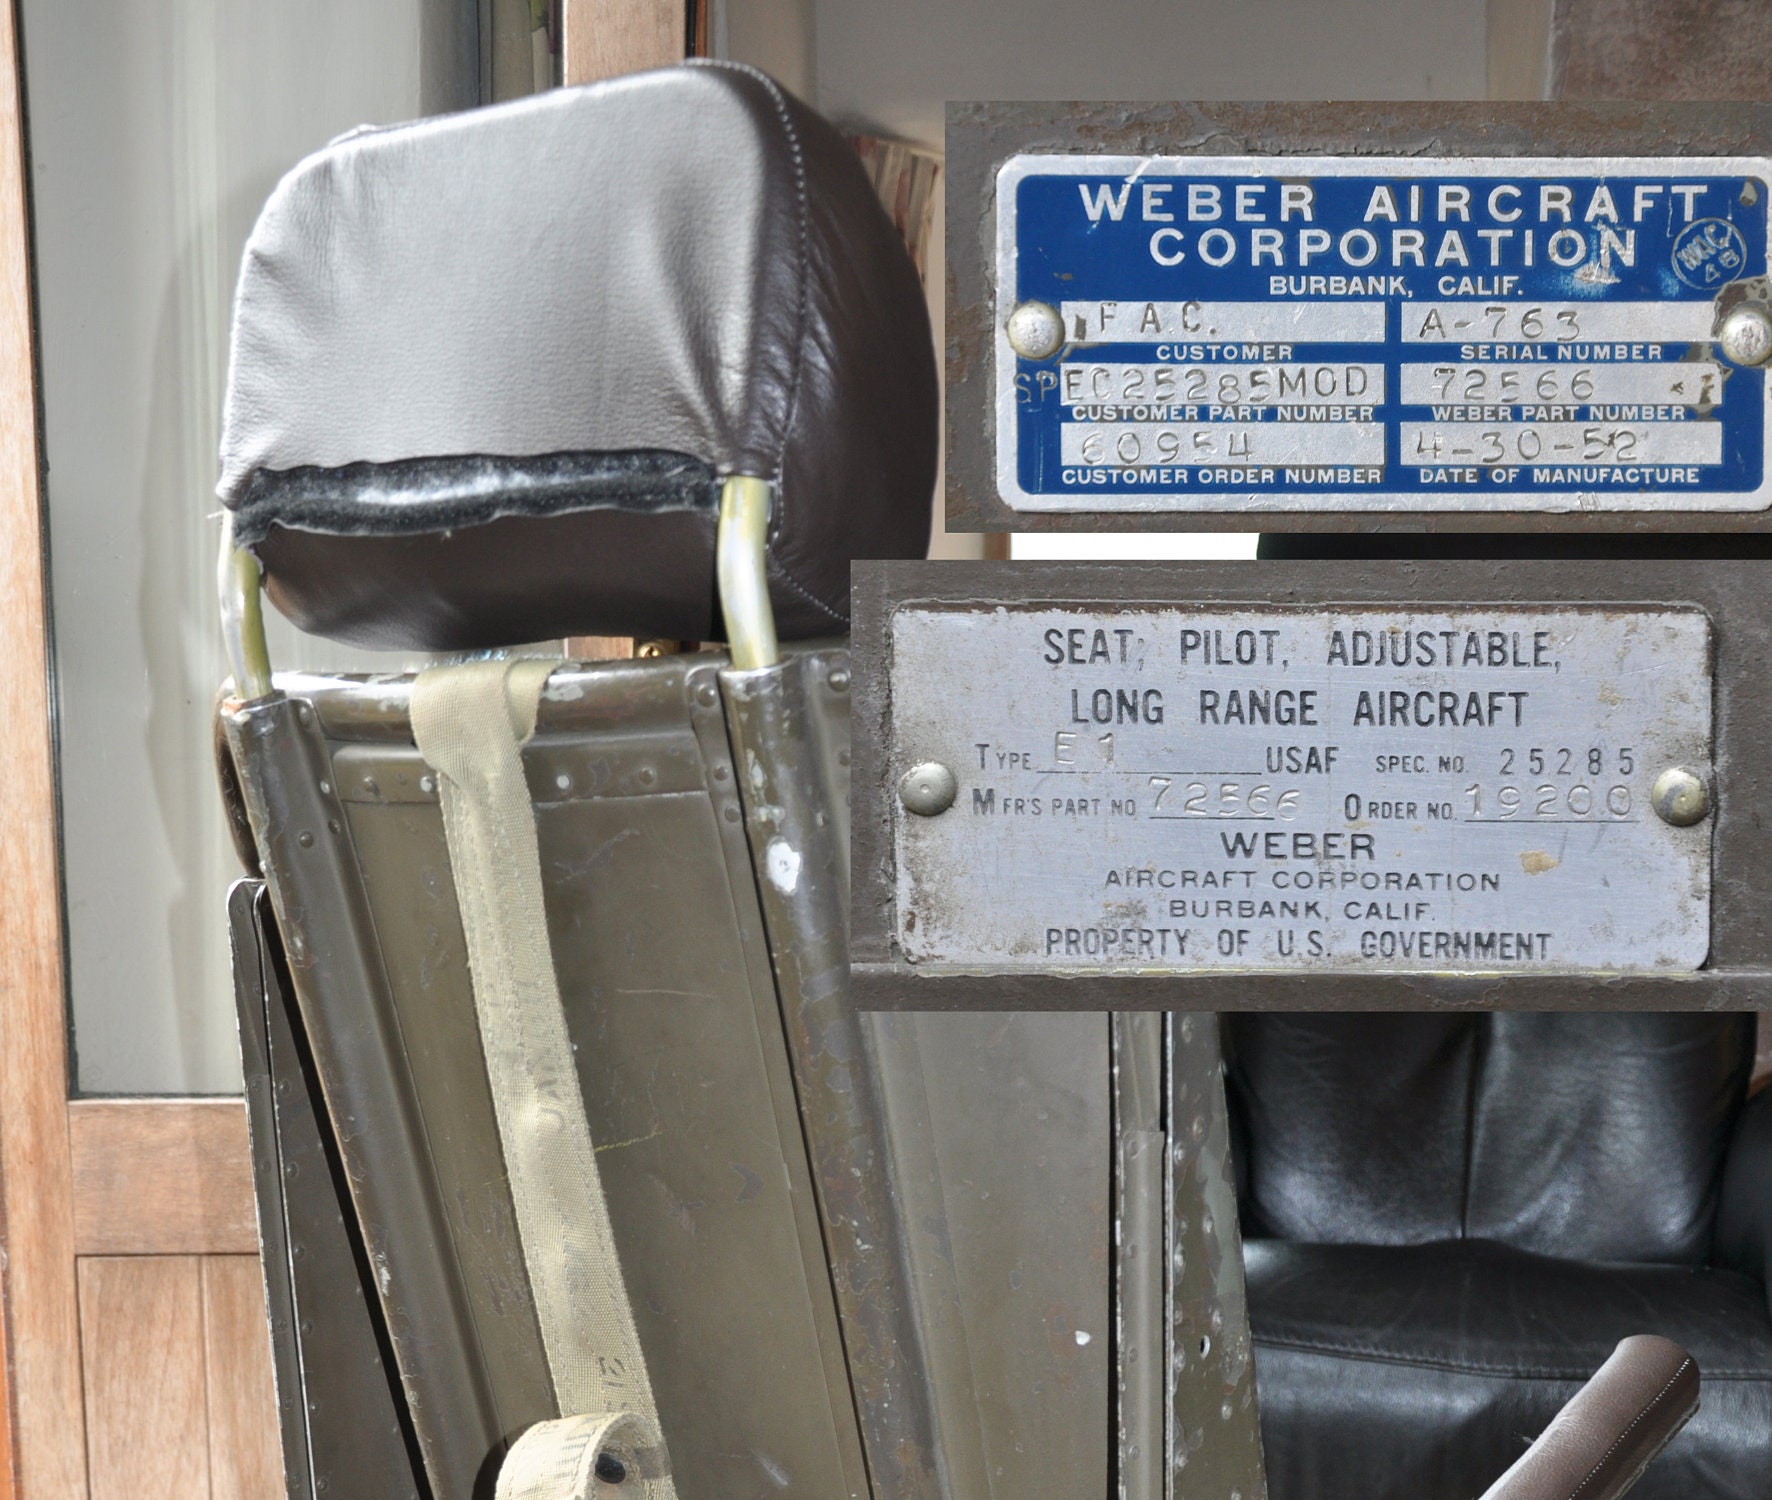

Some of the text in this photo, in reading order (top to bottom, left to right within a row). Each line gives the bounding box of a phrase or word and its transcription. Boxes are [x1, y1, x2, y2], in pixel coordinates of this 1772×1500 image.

[1077, 184, 1708, 224] WEBER AIRCRAFT
[1148, 228, 1637, 268] CORPORATION
[1269, 275, 1525, 299] BURBANK, CALIF.
[1418, 306, 1581, 342] A-763
[1155, 345, 1293, 361] CUSTOMER
[1460, 345, 1663, 361] SERIAL NUMBER
[1433, 367, 1595, 404] 72566
[1071, 405, 1374, 422] CUSTOMER PART NUMBER
[1432, 405, 1686, 422] WEBER PART NUMBER
[1081, 431, 1252, 464] 60954
[1415, 427, 1638, 464] 4-30-52
[1061, 468, 1382, 485] CUSTOMER ORDER NUMBER
[1419, 468, 1700, 484] DATE OF MANUFACTURE
[1180, 628, 1289, 671] PILOT,
[1327, 630, 1562, 674] ADJUSTABLE,
[1070, 687, 1530, 728] LONG RANGE AIRCRAFT
[1265, 746, 1339, 775] USAF
[1375, 755, 1430, 774] SPEC.
[1499, 748, 1635, 776] 25285
[1052, 798, 1101, 817] PART
[1148, 776, 1300, 822] 72566
[1427, 801, 1458, 821] NO.
[1464, 783, 1634, 820] 19200
[1219, 831, 1376, 861] WEBER
[1104, 870, 1501, 892] AIRCRAFT CORPORATION
[1169, 899, 1437, 922] BURBANK, CALIF.
[1046, 928, 1553, 961] PROPERTY OF U.S. GOVERNMENT
